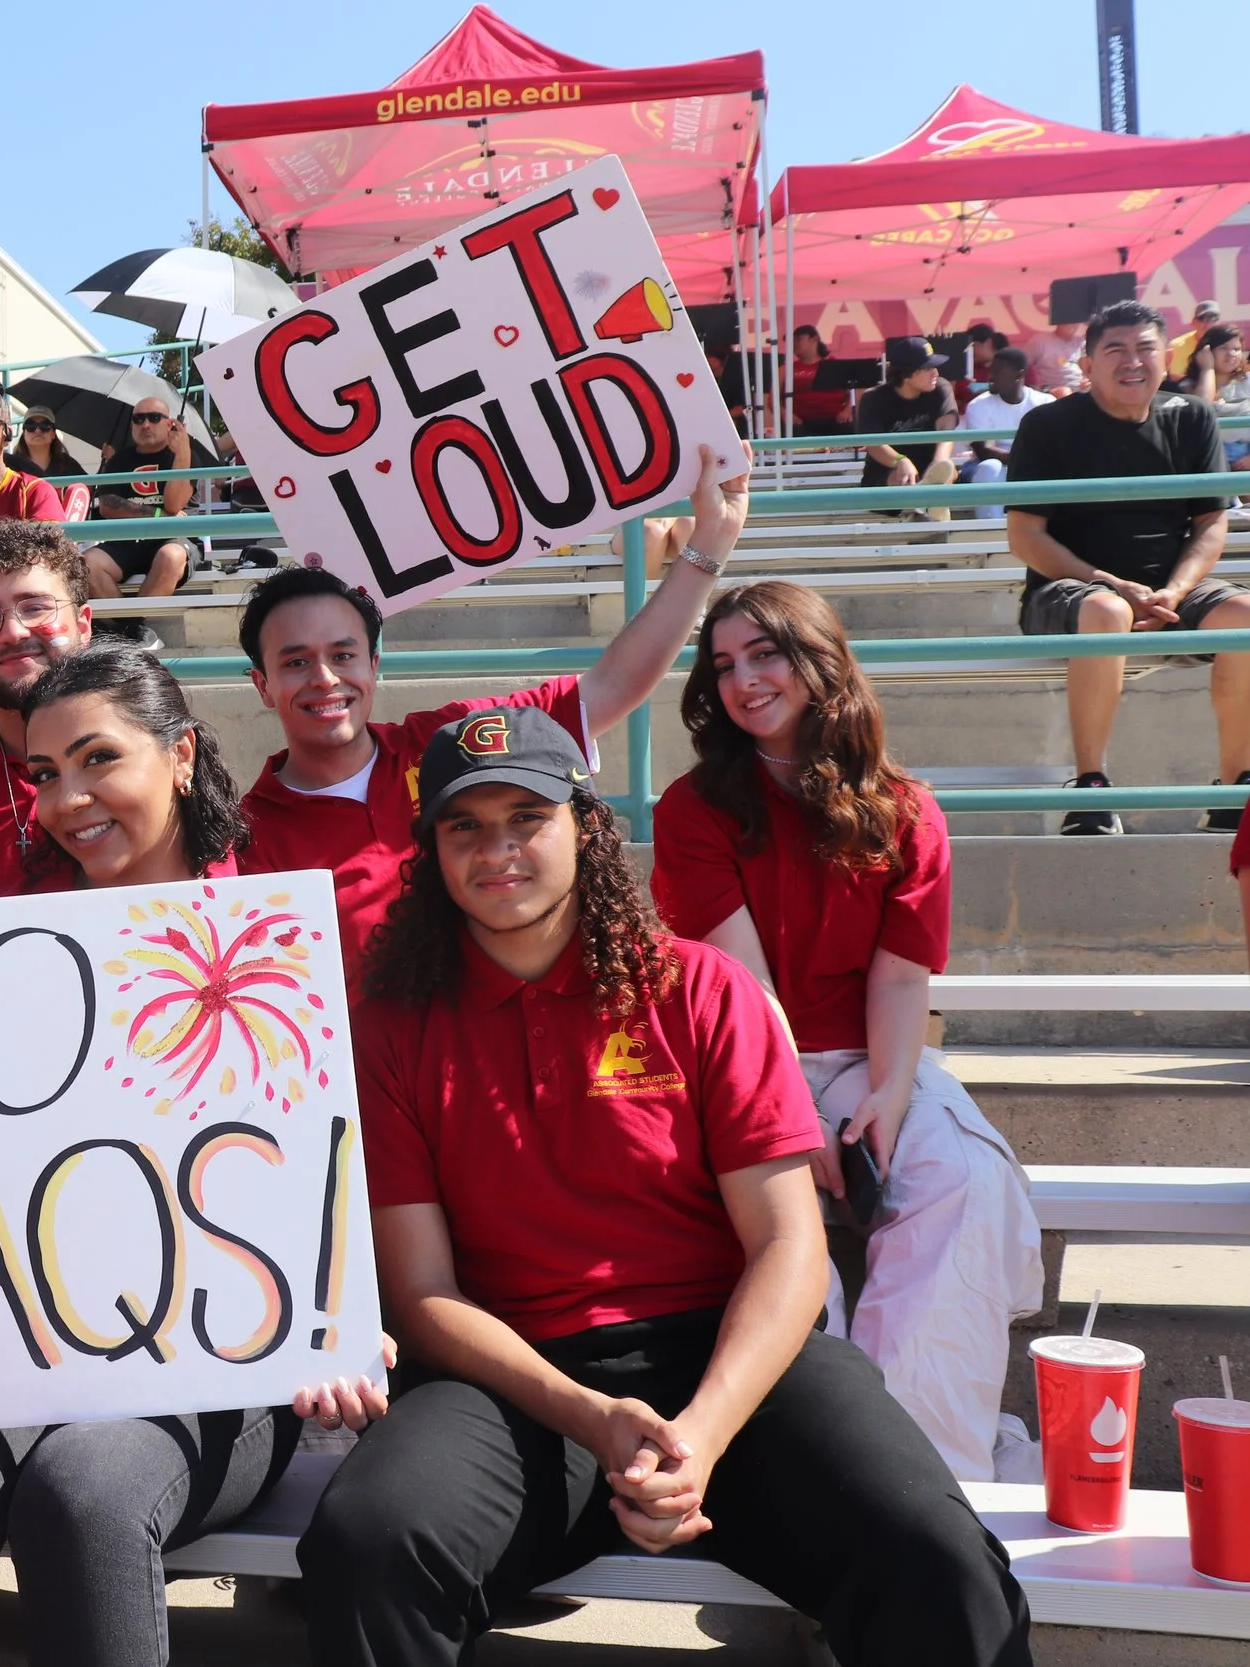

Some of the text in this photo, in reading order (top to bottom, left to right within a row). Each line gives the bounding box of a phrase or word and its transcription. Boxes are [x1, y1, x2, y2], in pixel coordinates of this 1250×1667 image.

[375, 81, 582, 121] glendale.edu
[253, 187, 589, 458] GET
[327, 351, 681, 599] LOUD
[456, 715, 511, 755] G
[586, 1088, 617, 1098] Glendale
[619, 1085, 659, 1096] Community
[593, 1072, 679, 1088] ASSOCIATED STUDENTS
